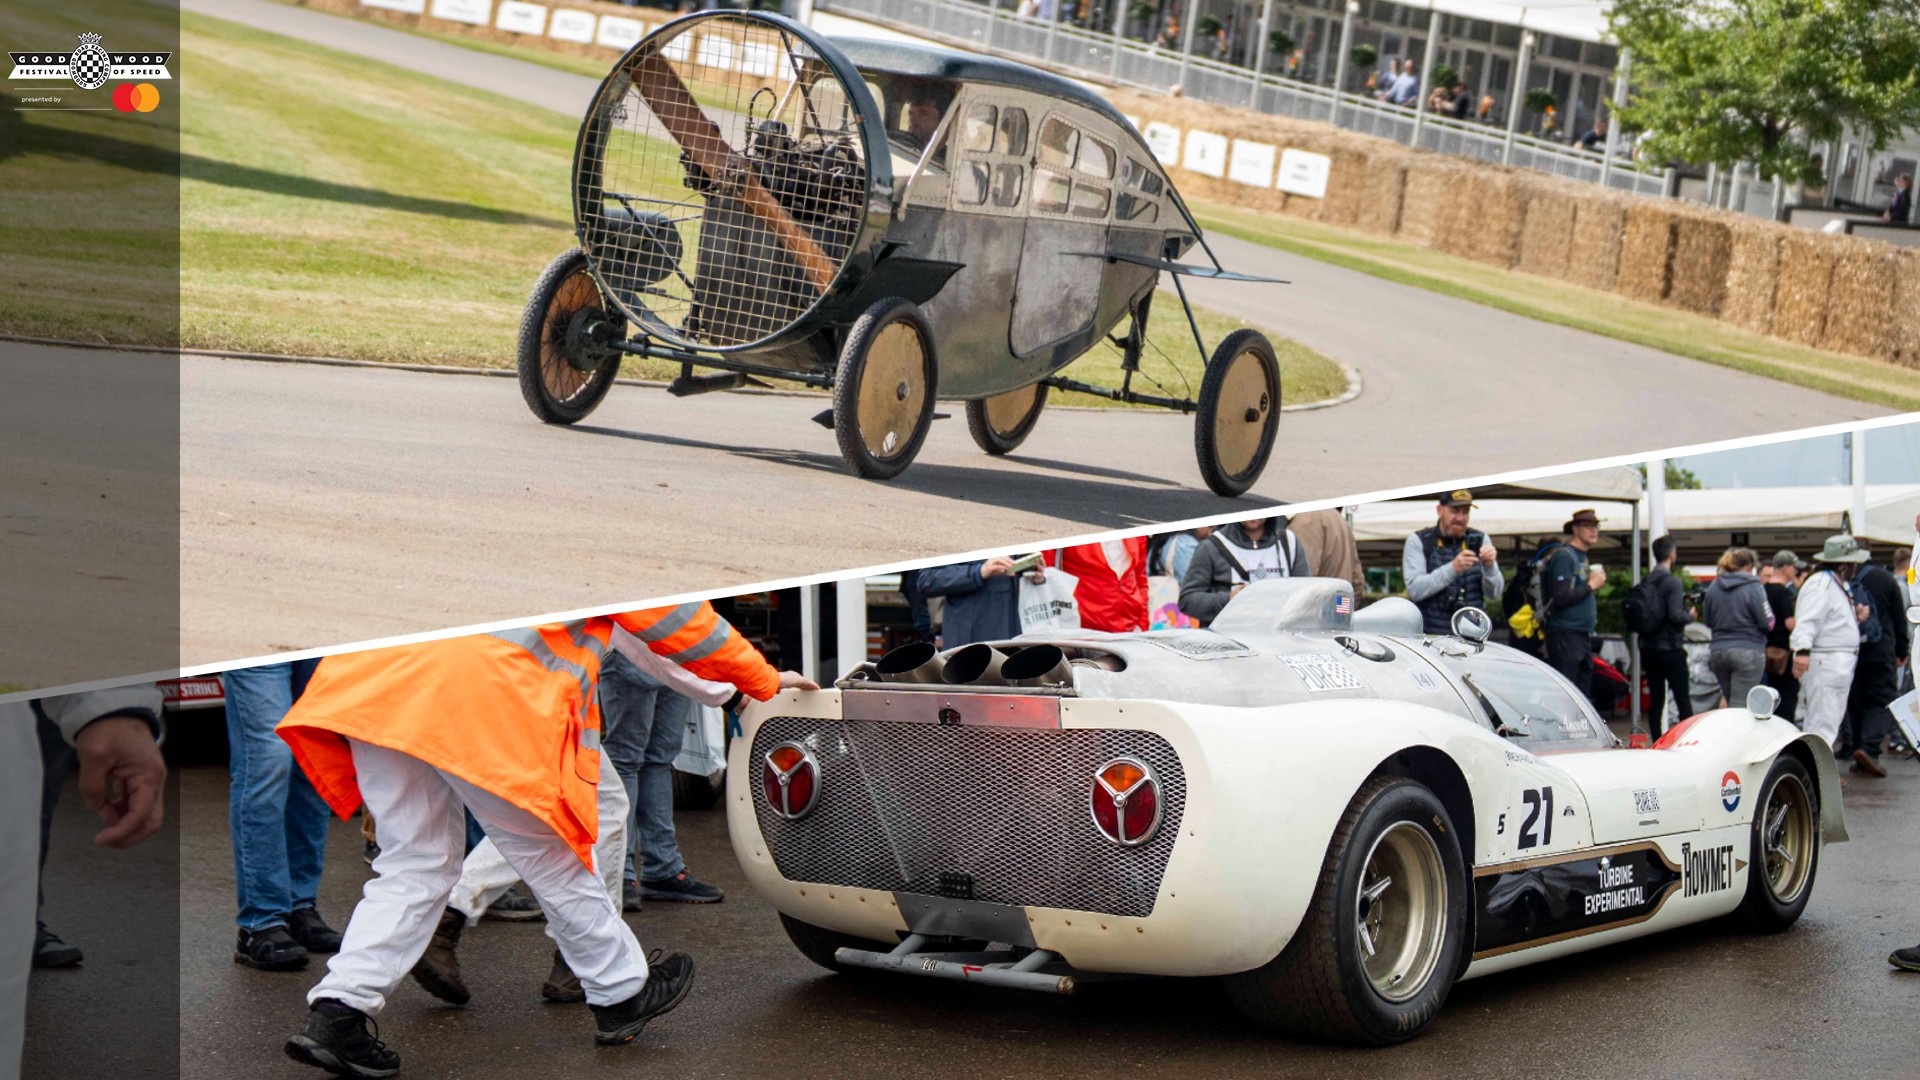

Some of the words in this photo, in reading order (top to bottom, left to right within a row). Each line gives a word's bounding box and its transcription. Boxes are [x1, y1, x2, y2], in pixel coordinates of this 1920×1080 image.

[180, 682, 220, 697] STRIKE
[1290, 663, 1342, 690] PURE
[1518, 786, 1553, 850] 21
[1598, 864, 1634, 889] TURBINE
[1682, 842, 1734, 898] HOWMET
[1584, 886, 1645, 916] EXPERIMENTAL
